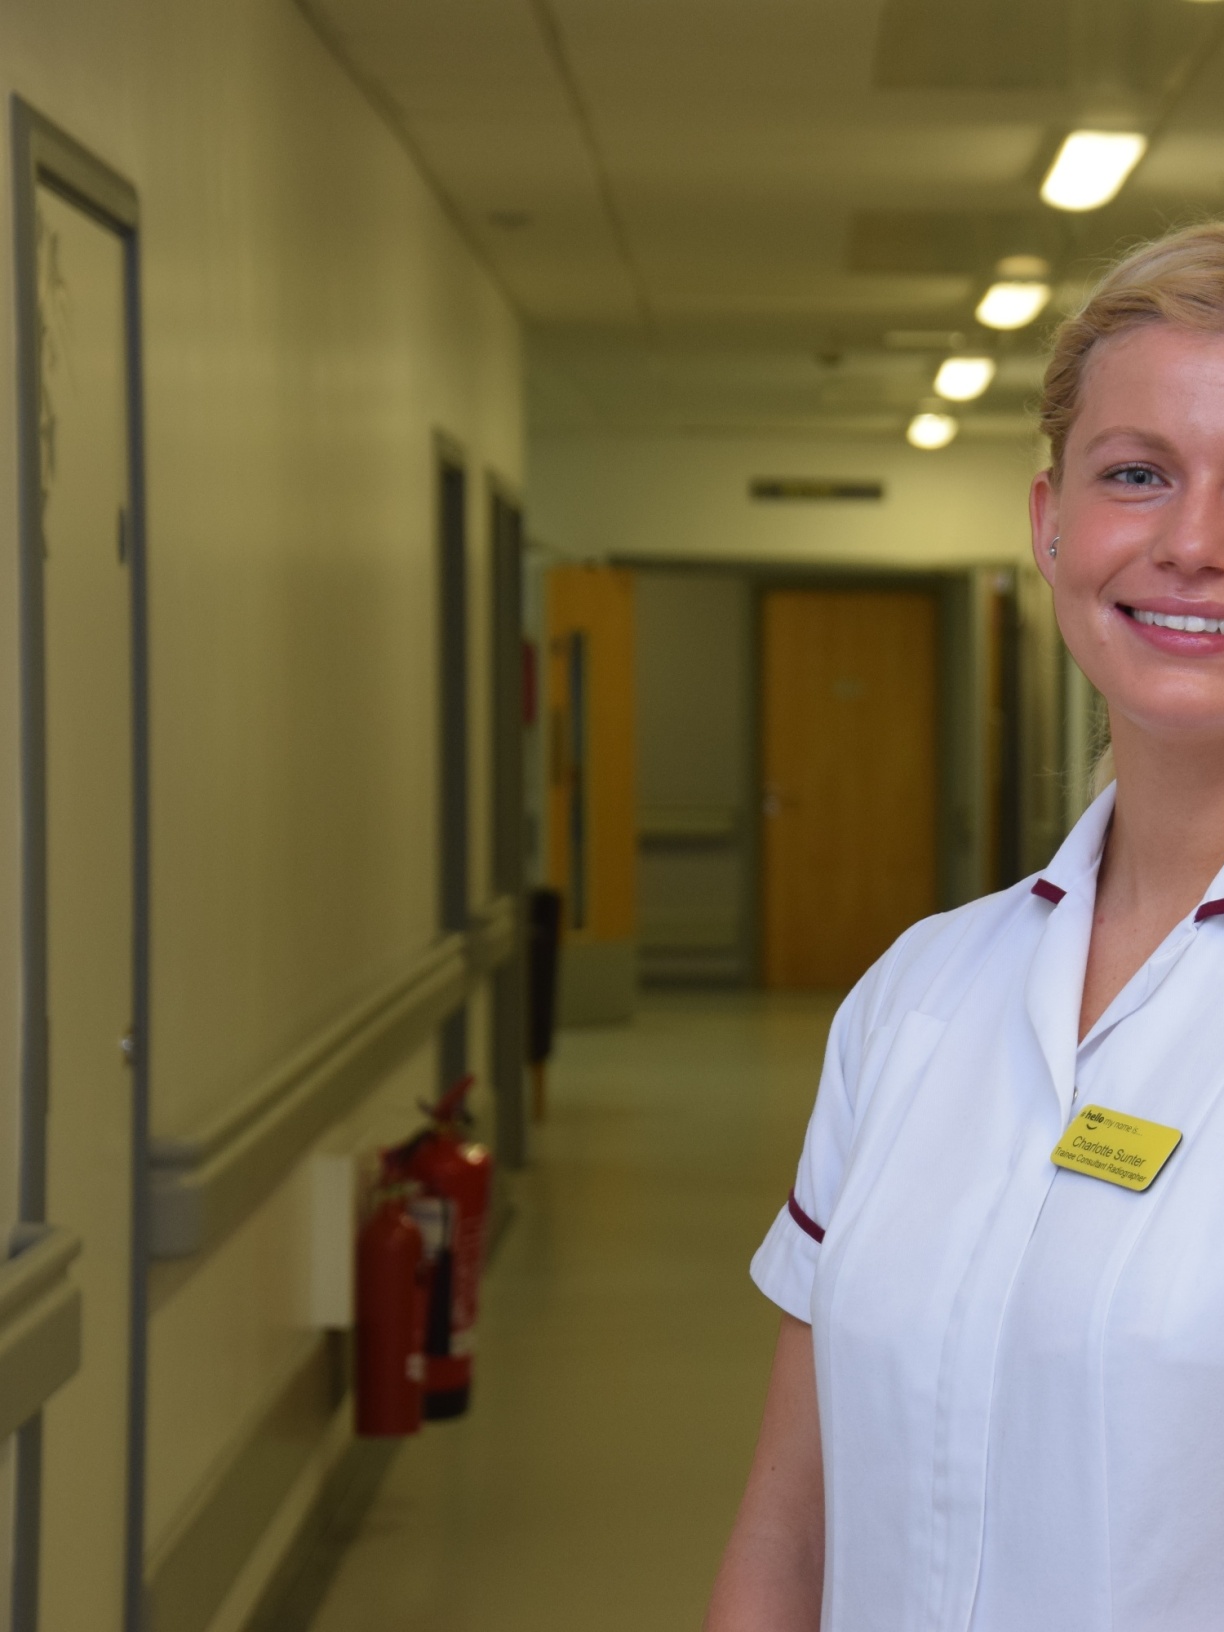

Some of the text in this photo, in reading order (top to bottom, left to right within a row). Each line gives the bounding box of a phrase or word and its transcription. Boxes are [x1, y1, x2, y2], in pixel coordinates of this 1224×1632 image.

[1103, 1119, 1115, 1129] my
[1114, 1122, 1133, 1133] name
[1055, 1146, 1147, 1183] Trainee Consultant Radiographer
[1072, 1135, 1147, 1168] Charlotte Sunter
